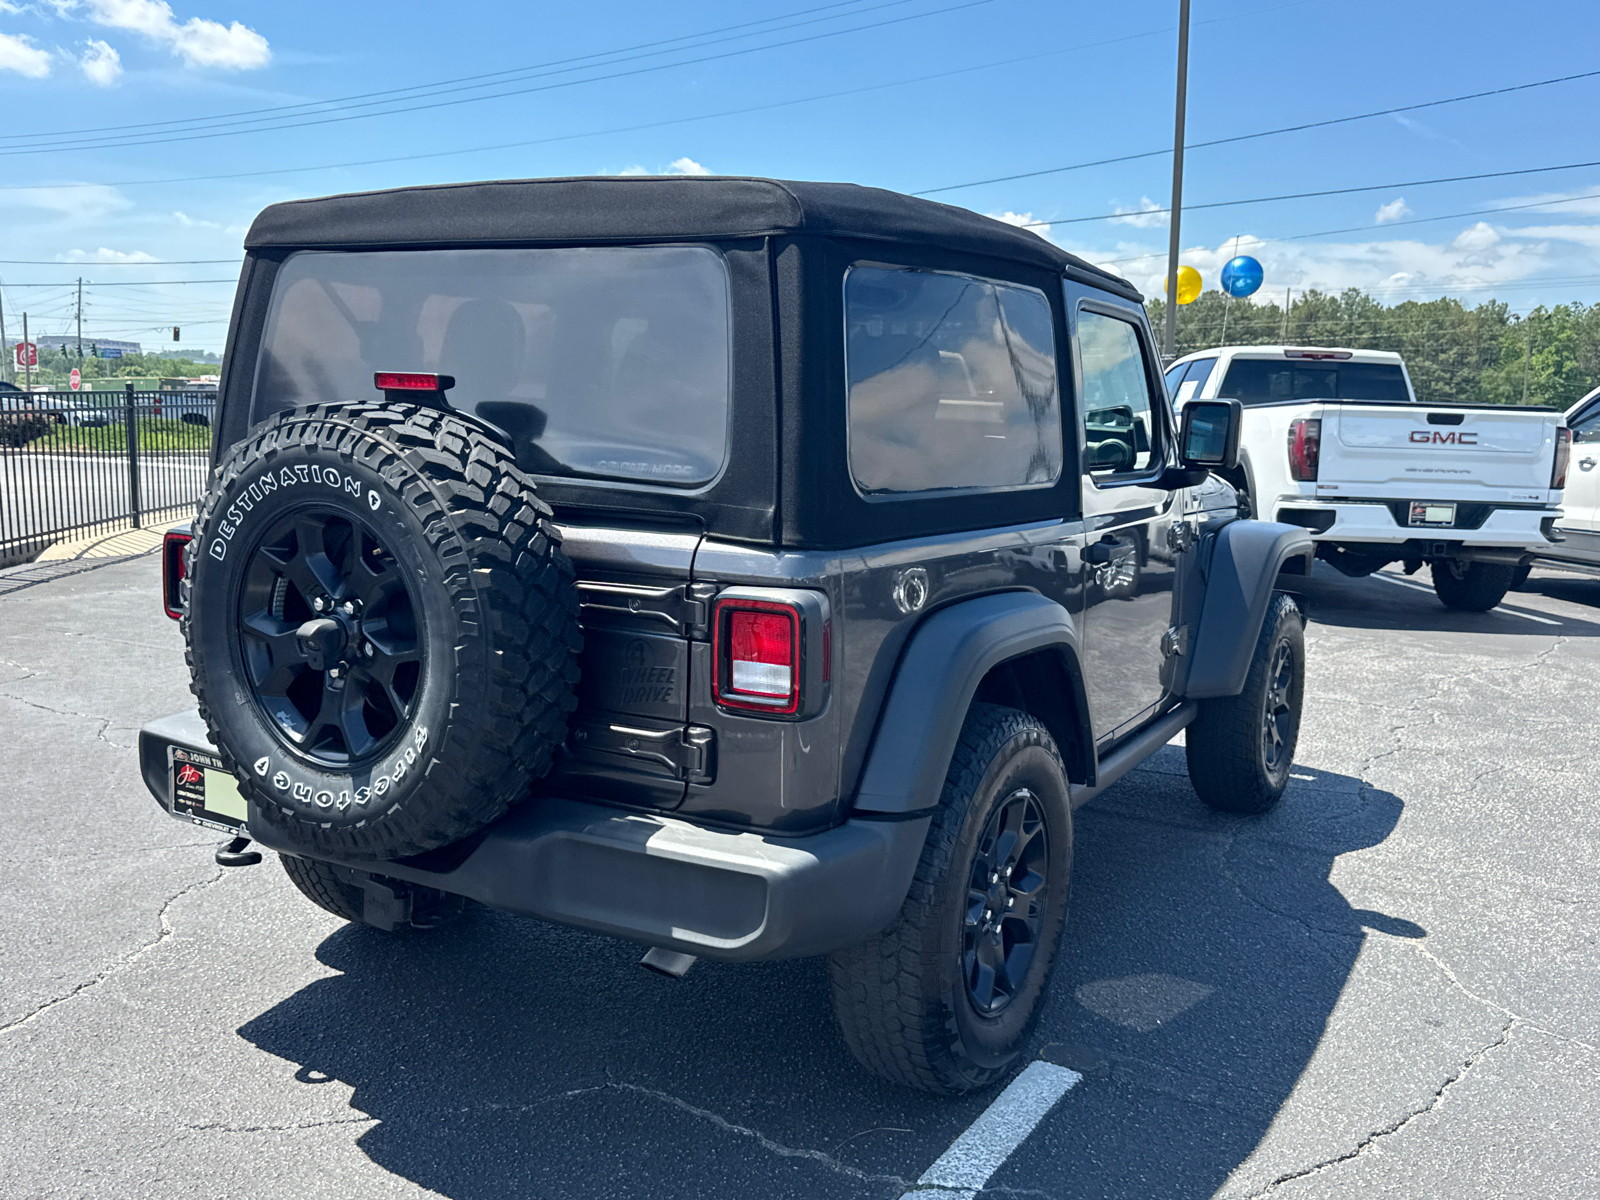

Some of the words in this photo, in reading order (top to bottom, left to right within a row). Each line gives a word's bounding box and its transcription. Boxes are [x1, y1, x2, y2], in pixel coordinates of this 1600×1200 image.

[1409, 431, 1477, 444] GMC
[209, 465, 361, 561] DESTINATION
[621, 666, 675, 684] WHEEL
[622, 686, 673, 703] DRIVE
[190, 753, 211, 765] JOHN
[273, 725, 428, 810] Firestone
